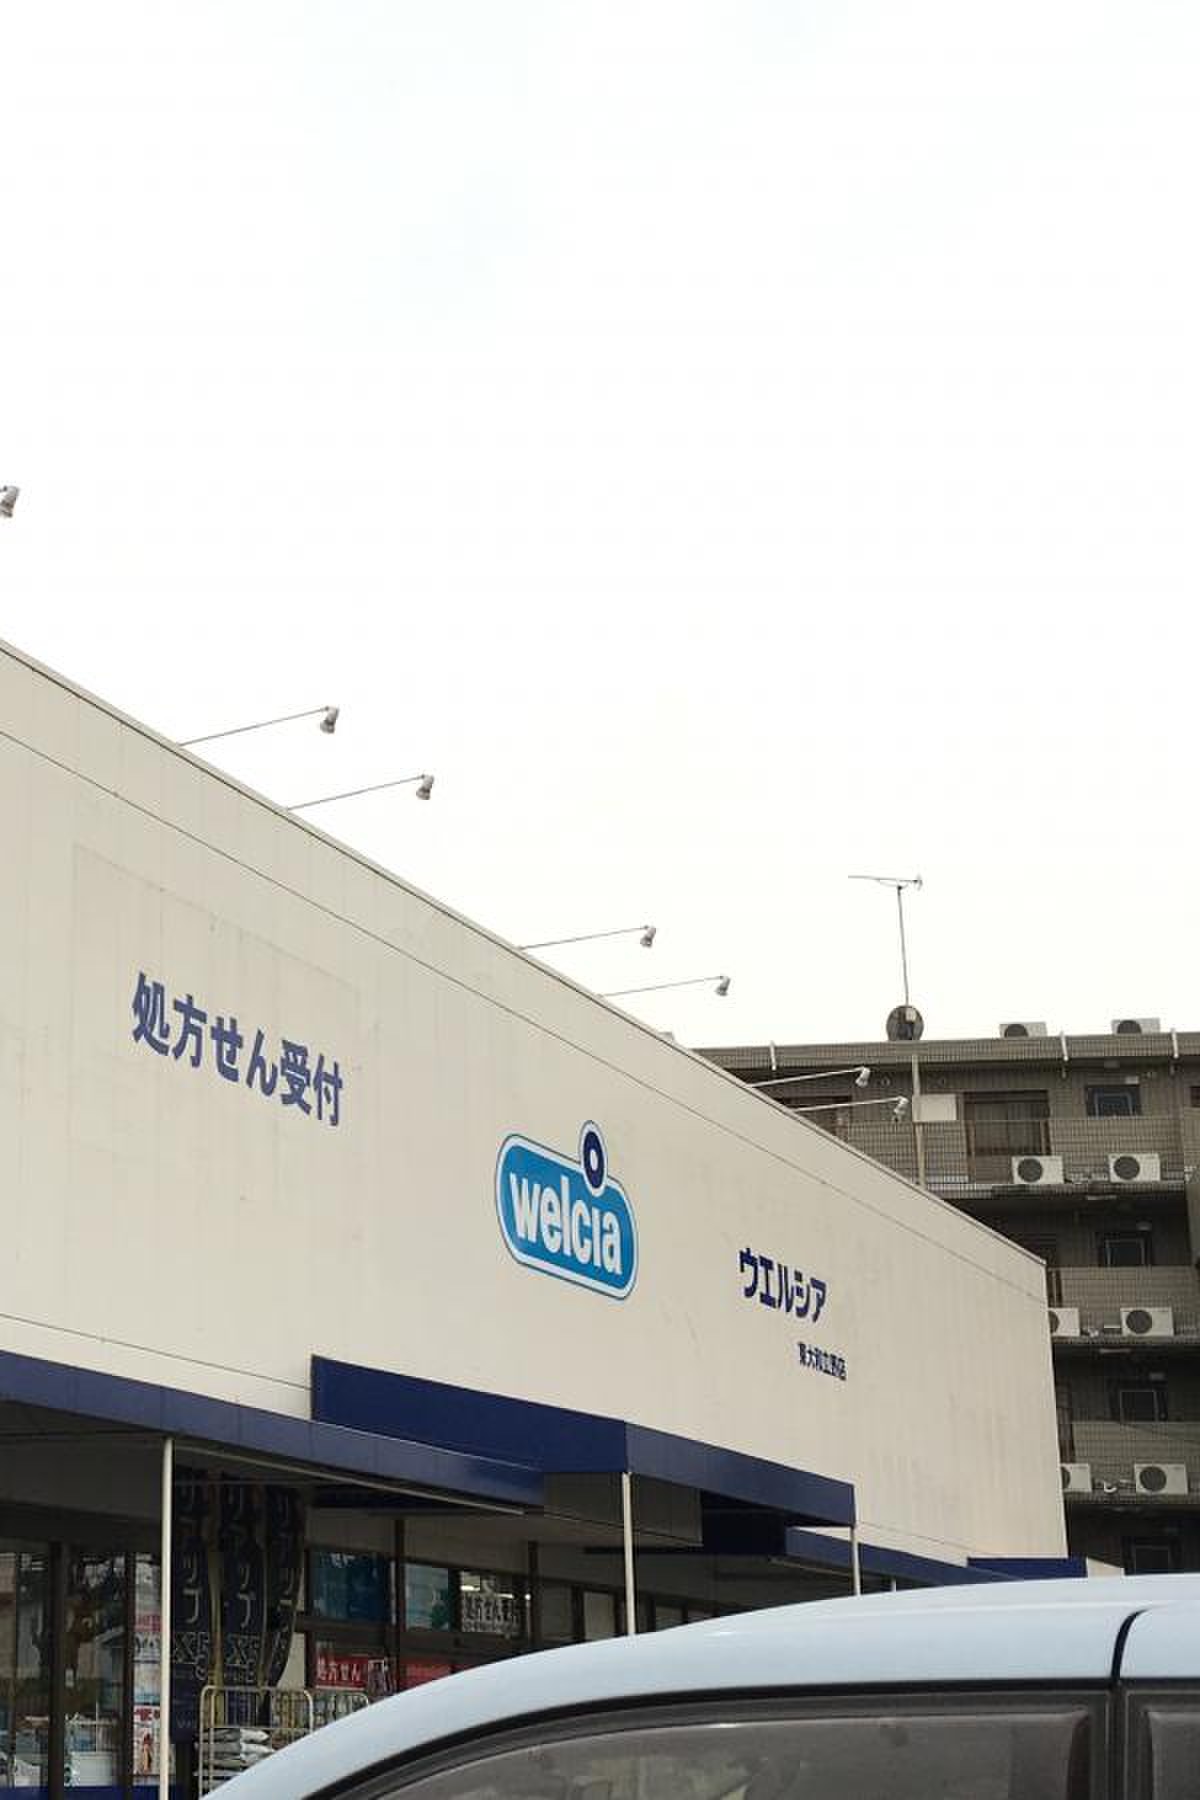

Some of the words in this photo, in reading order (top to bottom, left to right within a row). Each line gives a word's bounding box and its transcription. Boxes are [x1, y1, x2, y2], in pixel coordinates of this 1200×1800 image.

[132, 971, 343, 1126] 処方せん受付
[509, 1130, 623, 1276] welcia
[738, 1246, 828, 1324] ウエルシア
